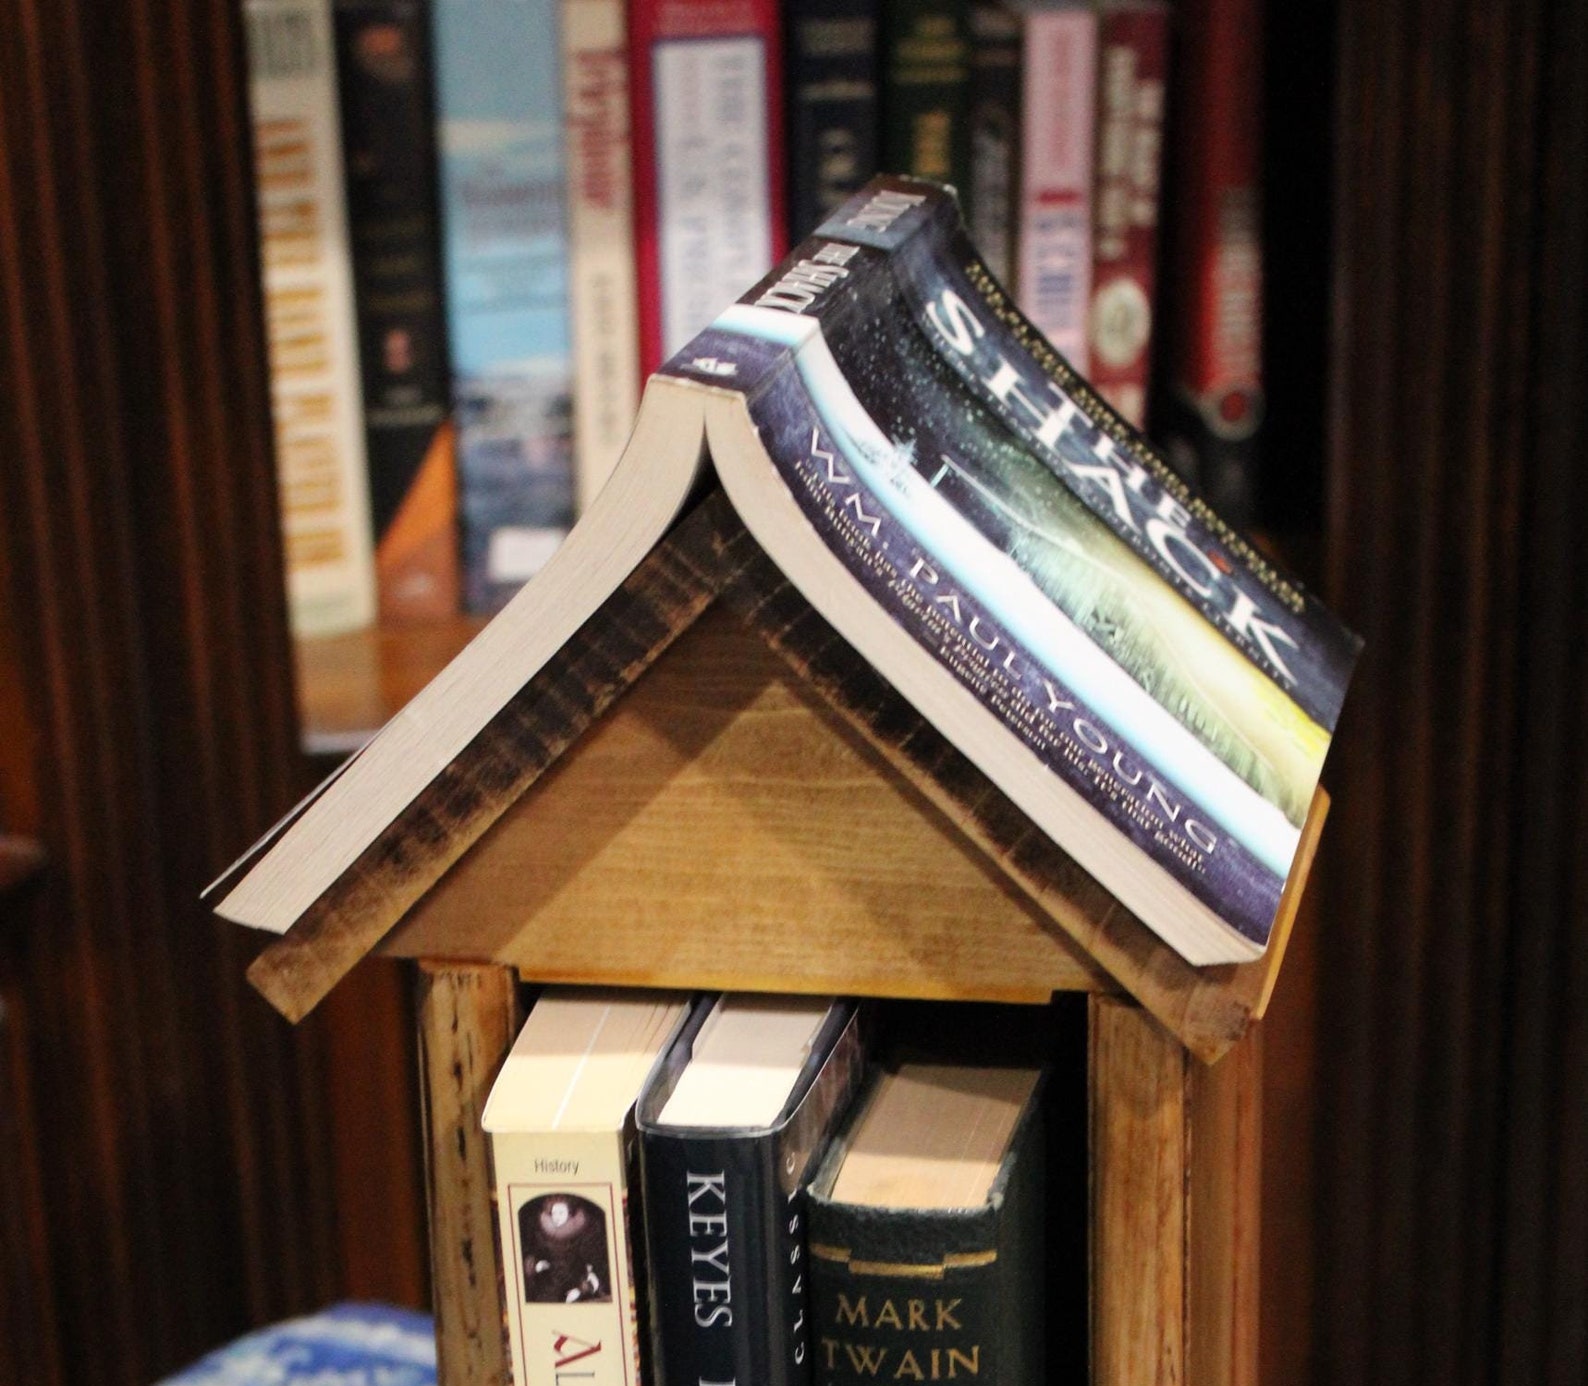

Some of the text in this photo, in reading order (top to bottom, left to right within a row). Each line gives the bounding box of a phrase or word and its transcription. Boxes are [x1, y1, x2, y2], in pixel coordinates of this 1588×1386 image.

[922, 286, 1300, 685] SHACK
[1046, 379, 1193, 535] THE
[811, 426, 1221, 854] WM. PAUL YOUNG
[534, 1159, 579, 1175] History
[686, 1169, 733, 1327] KEYES
[787, 1152, 805, 1365] CLASSIC
[835, 1294, 963, 1331] MARK
[821, 1337, 980, 1380] TWAIN
